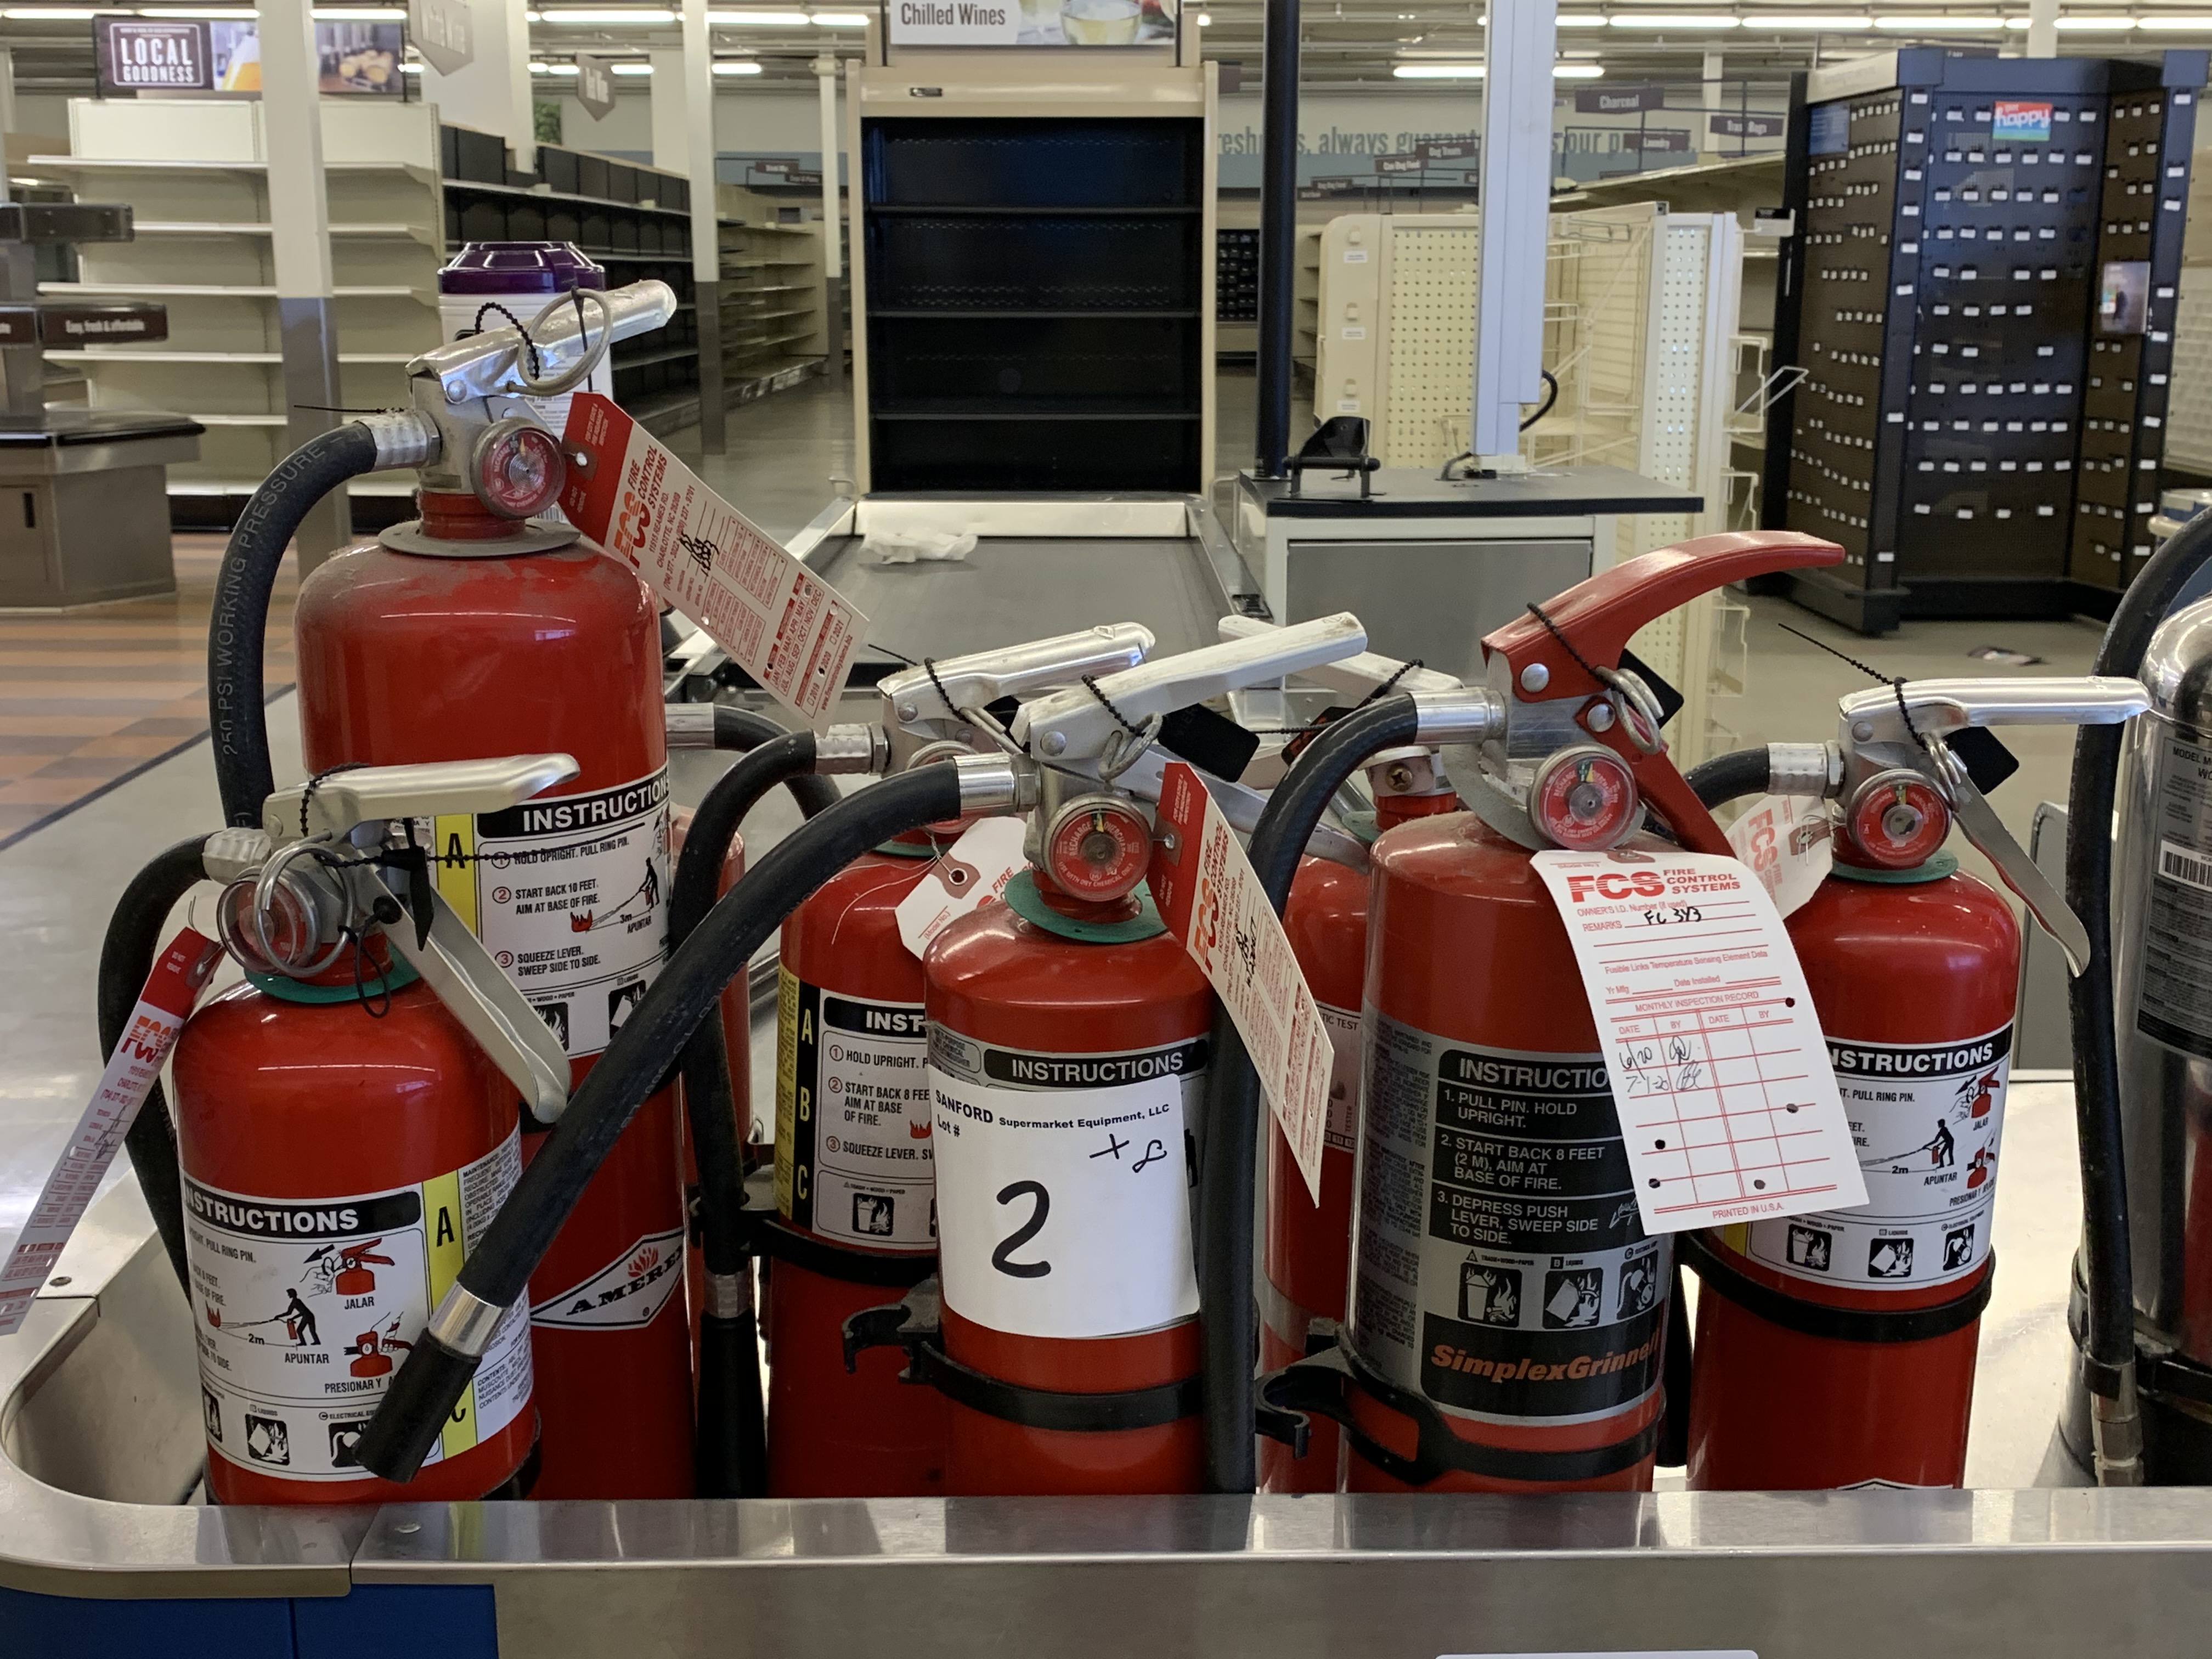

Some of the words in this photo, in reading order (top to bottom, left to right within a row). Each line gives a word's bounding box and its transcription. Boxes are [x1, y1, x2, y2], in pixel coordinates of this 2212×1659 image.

[901, 2, 955, 26] Chilled
[960, 3, 1006, 26] Wines
[121, 38, 193, 65] LOCAL
[123, 66, 194, 82] GOODNESS
[1599, 95, 1639, 109] Charcoal
[1994, 106, 2051, 128] happy
[1318, 126, 1387, 156] always
[1567, 133, 1601, 153] our
[627, 460, 641, 490] FIRE
[637, 443, 657, 501] CONTROL
[647, 453, 668, 510] SYSTEMS
[238, 443, 326, 549] PRESSURE
[614, 492, 651, 569] FCS
[653, 504, 665, 536] REAMES
[217, 558, 247, 668] WORKING
[771, 670, 782, 686] JAN
[777, 654, 787, 670] FEB
[782, 636, 793, 653] MAR
[789, 618, 800, 636] APR
[795, 601, 806, 618] MAY
[781, 678, 790, 693] JUL
[786, 660, 796, 678] AUG
[791, 644, 802, 660] SEP
[797, 626, 809, 644] OCT
[804, 607, 815, 626] NOV
[810, 590, 822, 608] DEC
[810, 682, 821, 701] 2019
[821, 651, 833, 670] 2020
[833, 620, 845, 639] 2021
[217, 676, 234, 711] PSI
[2172, 746, 2200, 764] MODEL
[446, 833, 465, 868] A
[580, 844, 599, 856] PULL
[600, 839, 617, 852] RING
[1748, 809, 1778, 872] FCS
[515, 888, 543, 900] START
[546, 884, 567, 896] BACK
[569, 882, 577, 892] 10
[579, 879, 599, 890] FEET.
[992, 866, 1014, 894] FIRE
[1566, 871, 1666, 903] FCS
[1667, 873, 1737, 884] CONTROL
[1672, 882, 1741, 894] SYSTEMS
[516, 903, 533, 915] AIM
[535, 901, 545, 912] AT
[548, 899, 568, 911] BASE
[570, 896, 580, 908] OF
[582, 893, 600, 906] FIRE.
[1577, 906, 1615, 917] OWNER'S
[1630, 902, 1657, 912] Number
[1583, 921, 1622, 932] REMARKS
[518, 951, 555, 964] SQUEEZE
[557, 946, 584, 960] LEVER.
[518, 964, 548, 976] SWEEP
[549, 961, 568, 973] SIDE
[570, 959, 580, 969] TO
[582, 955, 601, 967] SIDE.
[1605, 966, 1629, 974] Fusible
[1630, 963, 1649, 972] Links
[1650, 959, 1693, 969] Temperature
[1694, 956, 1722, 965] Sensing
[1723, 952, 1750, 961] Element
[1674, 979, 1690, 987] Date
[1691, 975, 1720, 984] Installed
[1635, 1001, 1673, 1012] MONTHLY
[1676, 996, 1724, 1008] INSPECTION
[1725, 991, 1759, 1001] RECORD
[802, 1009, 812, 1045] A
[1337, 1018, 1358, 1031] TEST
[1618, 1025, 1641, 1035] DATE
[1671, 1021, 1681, 1029] BY
[1708, 1015, 1730, 1024] DATE
[1758, 1011, 1770, 1019] BY
[847, 1050, 870, 1064] HOLD
[874, 1055, 919, 1069] UPRIGHT.
[1012, 1051, 1184, 1082] INSTRUCTIONS
[1829, 1042, 1993, 1073] NSTRUCTIONS
[1459, 1058, 1608, 1088] INSTRUCTIO
[845, 1082, 874, 1097] START
[877, 1087, 901, 1099] BACK
[912, 1089, 930, 1101] FEE
[1853, 1090, 1874, 1101] PULL
[1876, 1092, 1897, 1102] RING
[1899, 1093, 1915, 1102] PIN.
[800, 1086, 810, 1121] B
[845, 1096, 861, 1109] AIM
[864, 1099, 876, 1111] AT
[878, 1101, 902, 1114] BASE
[935, 1090, 994, 1124] SANFORD
[999, 1117, 1074, 1130] Supermarket
[1077, 1111, 1146, 1128] Equipment,
[1148, 1103, 1170, 1117] LLC
[1458, 1092, 1497, 1110] PULL
[1501, 1099, 1529, 1114] PIN.
[1535, 1102, 1577, 1115] HOLD
[844, 1110, 856, 1121] OF
[858, 1114, 881, 1126] FIRE.
[937, 1114, 951, 1134] Lot
[1458, 1107, 1526, 1128] UPRIGHT.
[1849, 1122, 1865, 1132] EET.
[843, 1141, 883, 1158] SQUEEZE
[885, 1147, 918, 1159] LEVER.
[1456, 1137, 1504, 1155] START
[1509, 1146, 1551, 1160] BACK
[1556, 1148, 1564, 1160] 8
[1569, 1147, 1605, 1160] FEET
[1454, 1167, 1494, 1184] BASE
[1499, 1175, 1521, 1187] OF
[1525, 1178, 1562, 1190] FIRE.
[1496, 1161, 1524, 1174] AIM
[1528, 1163, 1548, 1175] AT
[1924, 1172, 1957, 1186] APUNTAR
[798, 1165, 808, 1199] C
[1453, 1194, 1522, 1216] DEPRESS
[1527, 1205, 1568, 1218] PUSH
[1950, 1189, 1977, 1206] PRESIONAR
[1451, 1209, 1503, 1230] LEVER,
[1508, 1218, 1562, 1232] SWEEP
[1566, 1218, 1599, 1232] SIDE
[1712, 1207, 1749, 1219] PRINTED
[436, 1205, 455, 1248] A
[991, 1180, 1052, 1278] 2
[1451, 1223, 1470, 1237] TO
[1474, 1229, 1511, 1245] SIDE.
[222, 1244, 239, 1259] RING
[345, 1297, 375, 1310] JALAR
[248, 1334, 265, 1345] 2m
[284, 1353, 330, 1364] APUNTAR
[1431, 1327, 1660, 1383] SimplexGrinnell
[324, 1379, 374, 1393] PRESIONAR
